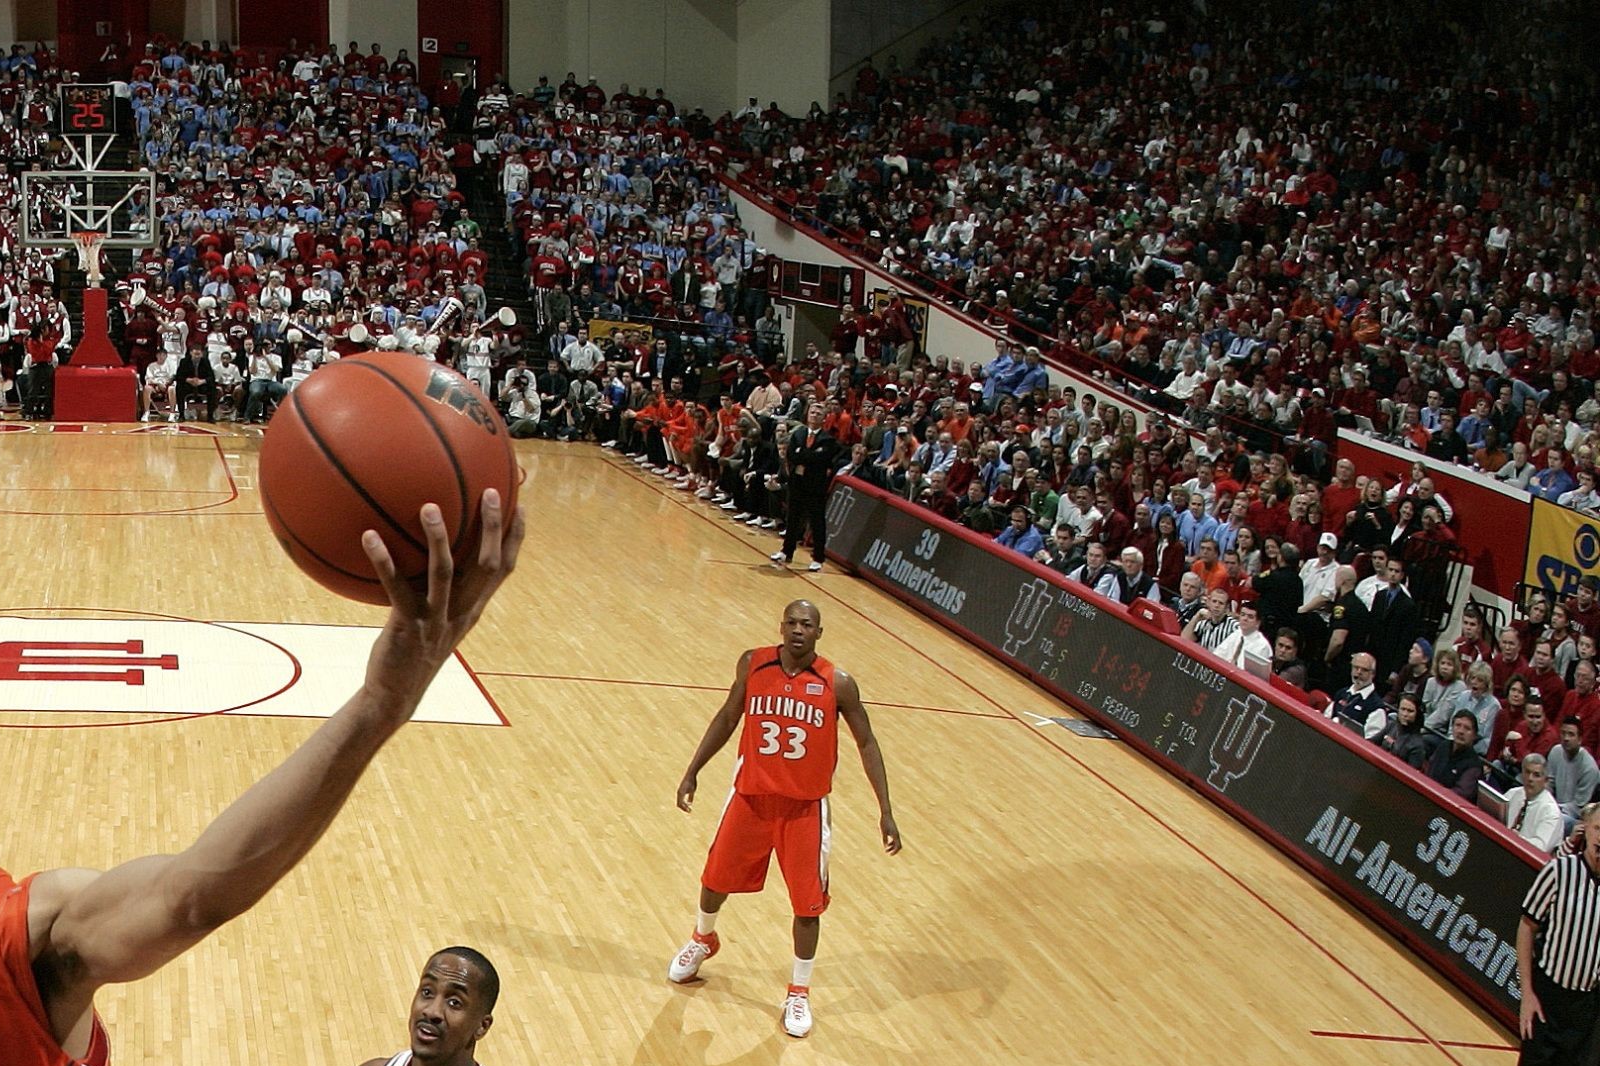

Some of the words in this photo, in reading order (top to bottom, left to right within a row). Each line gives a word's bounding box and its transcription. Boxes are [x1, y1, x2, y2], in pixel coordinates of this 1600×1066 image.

[426, 40, 436, 51] 2
[73, 103, 104, 128] 25
[915, 528, 940, 560] 39
[863, 538, 967, 616] All-Americans
[1057, 590, 1098, 621] INDIANA
[1039, 660, 1049, 674] F
[1170, 651, 1227, 692] ILLINOIS
[749, 695, 825, 728] ILLINOIS
[1100, 695, 1141, 729] PERIOD
[758, 720, 808, 760] 33
[1415, 815, 1470, 878] 39
